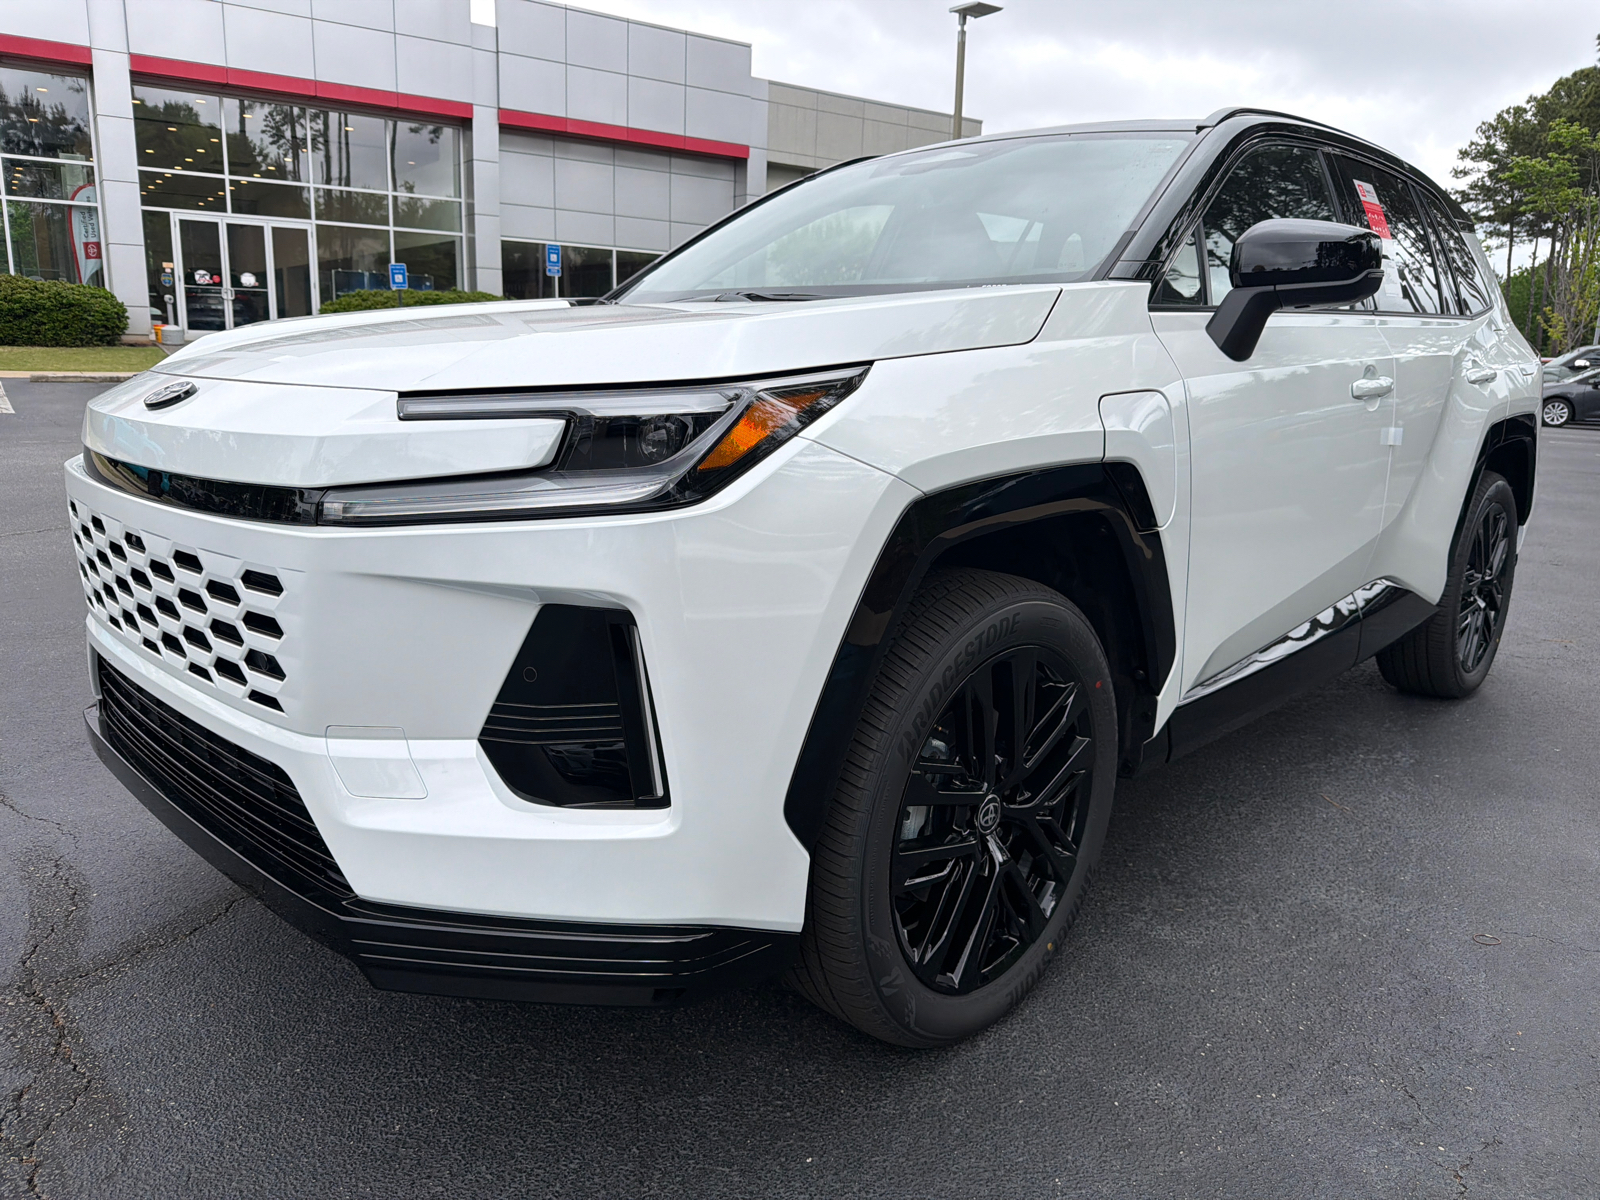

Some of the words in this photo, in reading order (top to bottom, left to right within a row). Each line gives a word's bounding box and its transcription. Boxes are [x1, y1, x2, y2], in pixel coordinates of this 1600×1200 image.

[80, 211, 89, 238] Certified
[88, 222, 97, 238] Used
[897, 612, 1021, 765] BRIDGESTONE
